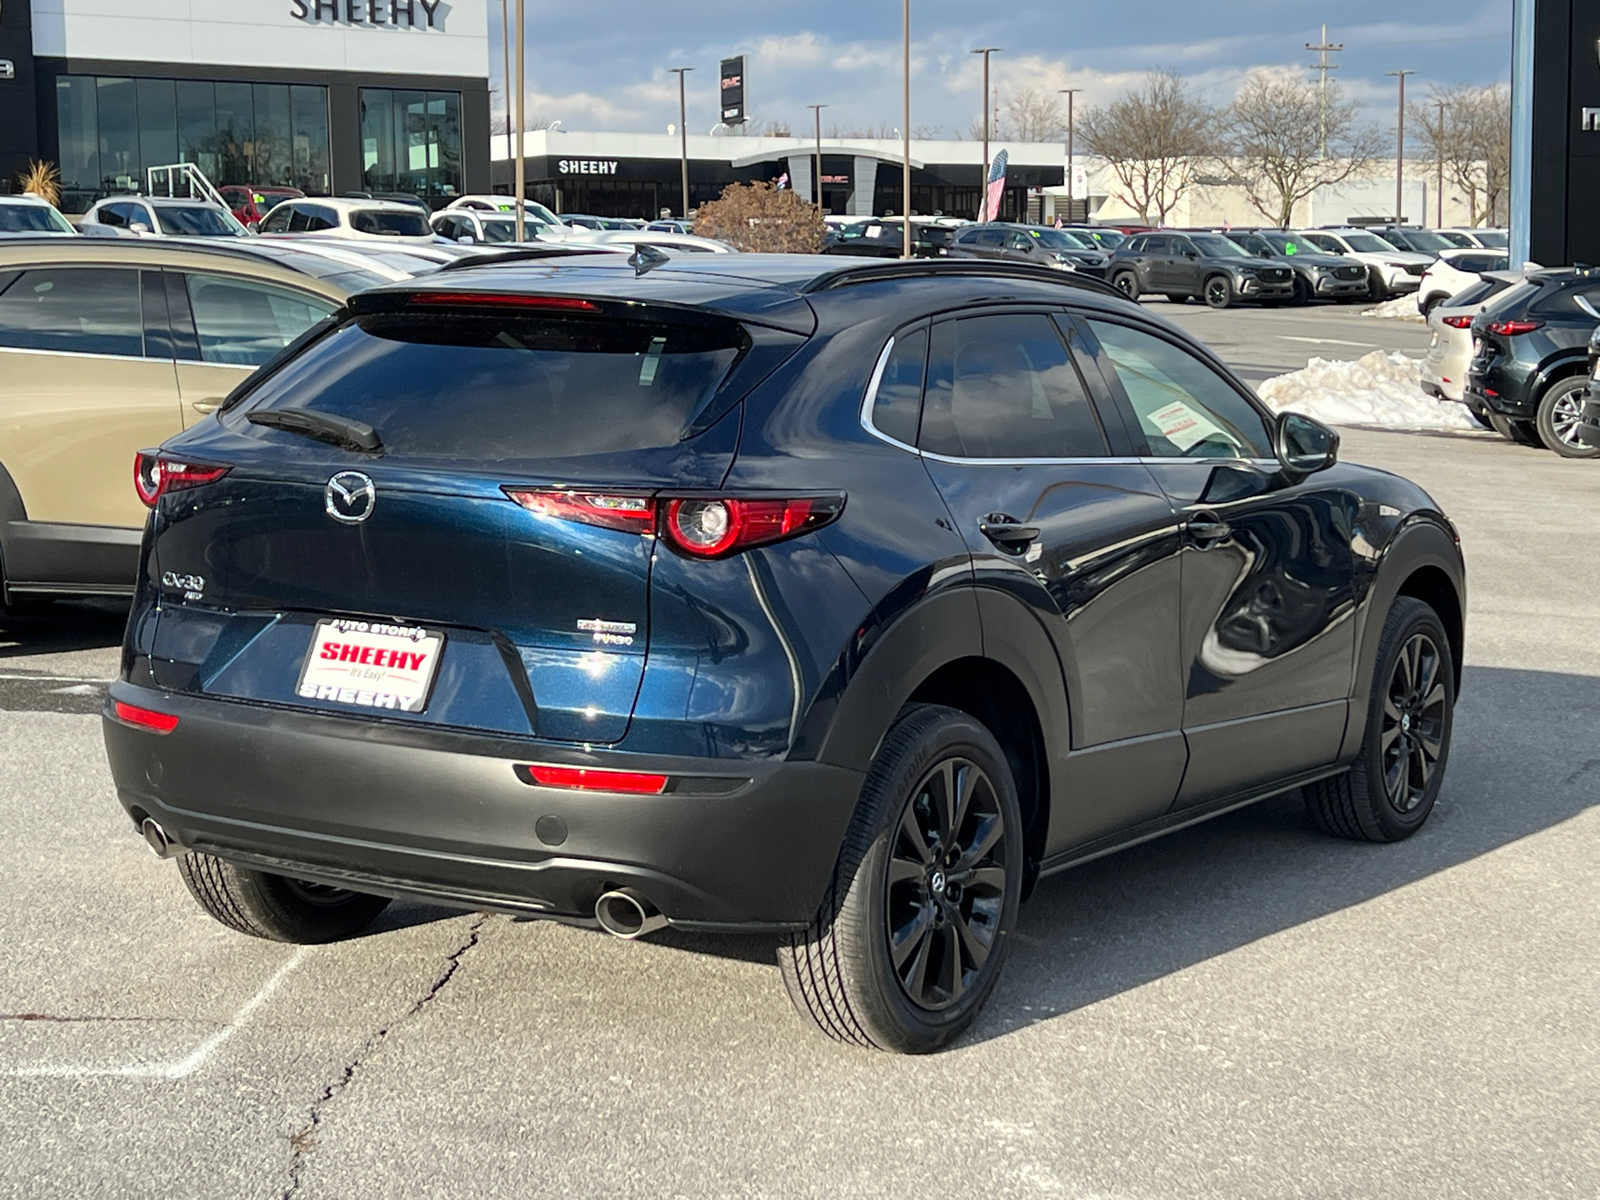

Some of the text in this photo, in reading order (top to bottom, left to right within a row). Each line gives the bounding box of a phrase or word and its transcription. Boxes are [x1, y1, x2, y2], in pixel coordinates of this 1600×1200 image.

[290, 0, 440, 27] SHEEHY
[558, 159, 618, 175] SHEEHY
[162, 571, 204, 592] CX-30
[330, 619, 368, 632] AUTO
[320, 641, 427, 671] SHEEHY
[363, 668, 387, 682] Easy!
[299, 682, 420, 711] SHEEHY
